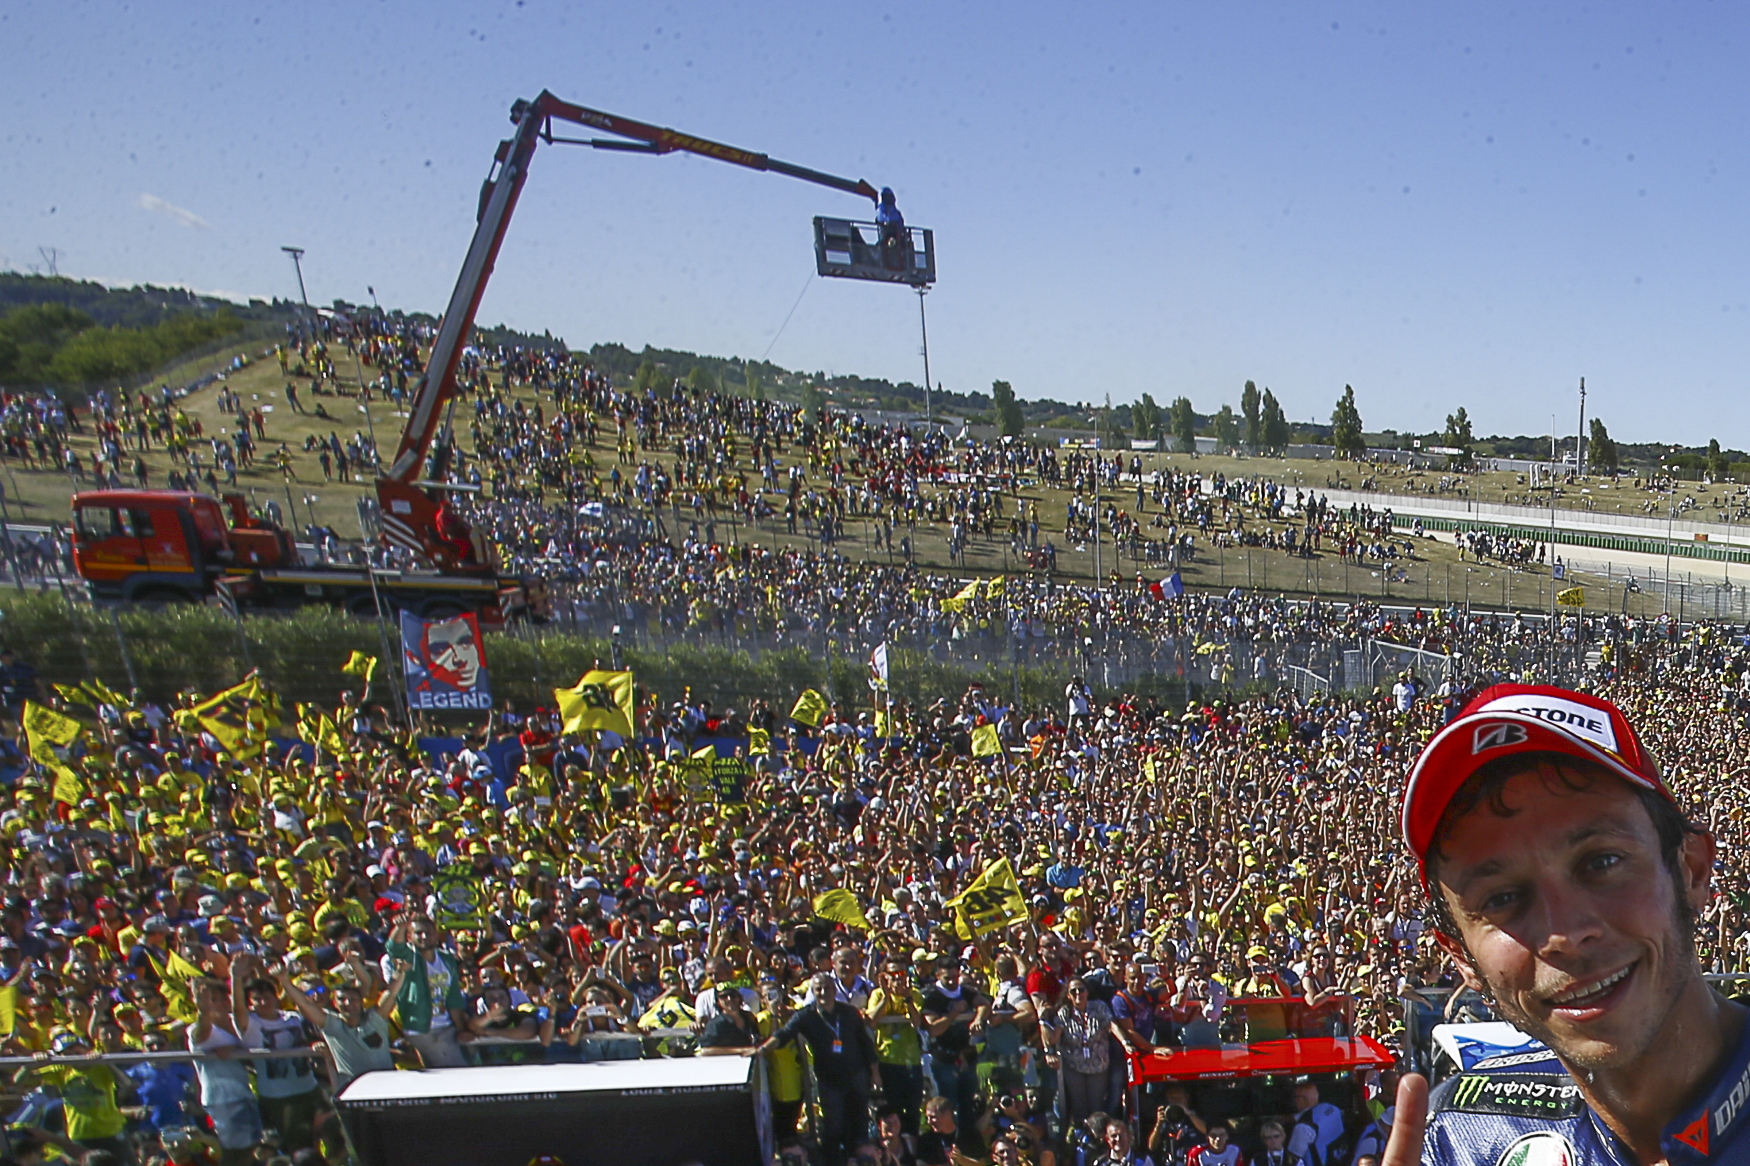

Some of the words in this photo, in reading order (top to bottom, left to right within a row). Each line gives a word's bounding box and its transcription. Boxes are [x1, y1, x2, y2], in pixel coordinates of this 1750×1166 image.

[411, 689, 493, 709] LEGEND
[1515, 706, 1604, 734] TONE
[1495, 1097, 1569, 1110] ENERGY
